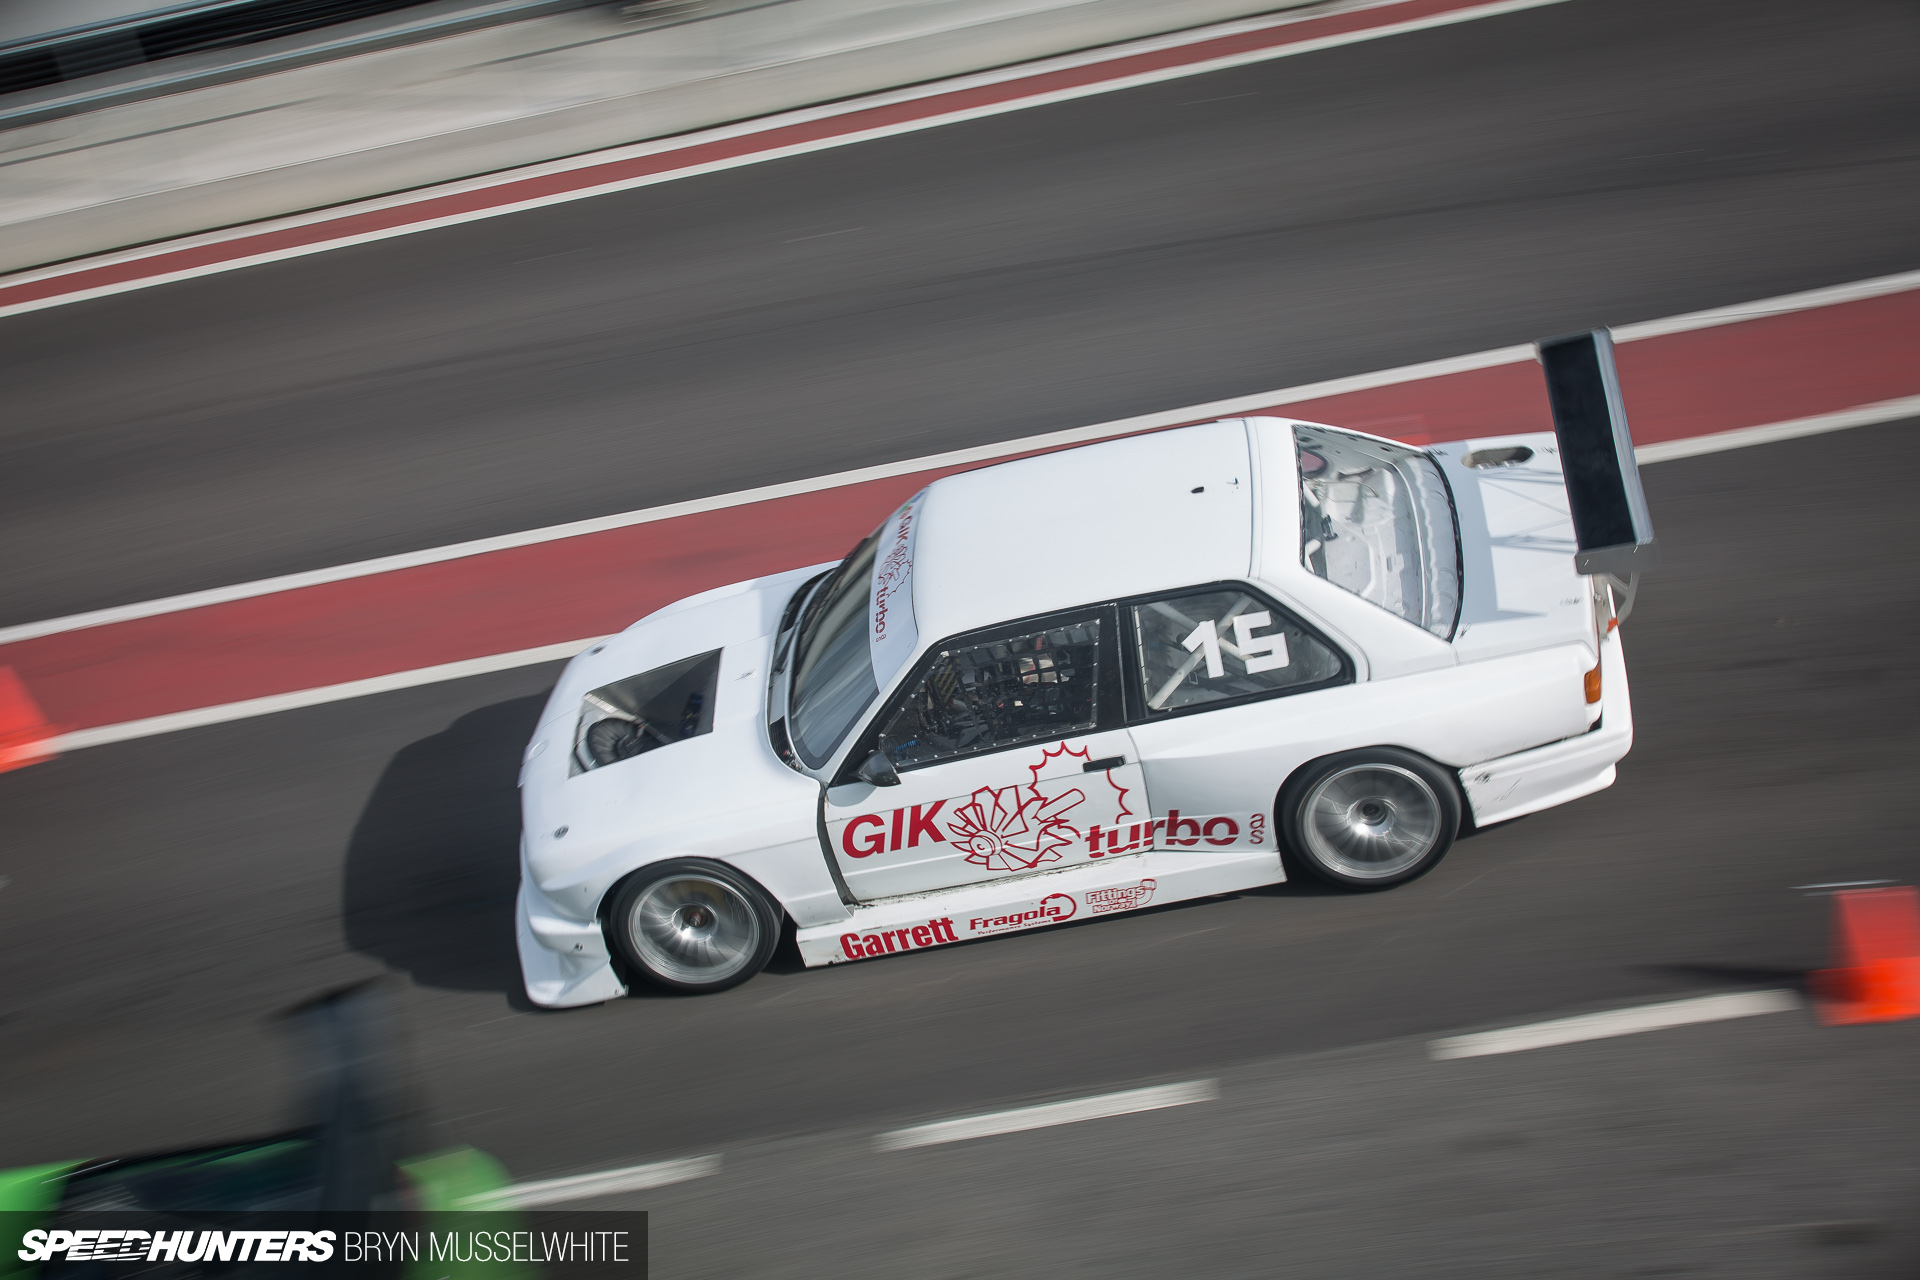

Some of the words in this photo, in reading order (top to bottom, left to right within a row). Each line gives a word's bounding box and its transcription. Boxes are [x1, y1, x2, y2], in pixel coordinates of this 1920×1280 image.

[875, 586, 888, 634] turbo
[1181, 610, 1289, 678] 15
[842, 799, 948, 859] GIK
[1085, 809, 1239, 858] turbo
[969, 900, 1063, 930] Fragola
[1085, 886, 1146, 904] Fittings
[840, 917, 959, 959] Garrett
